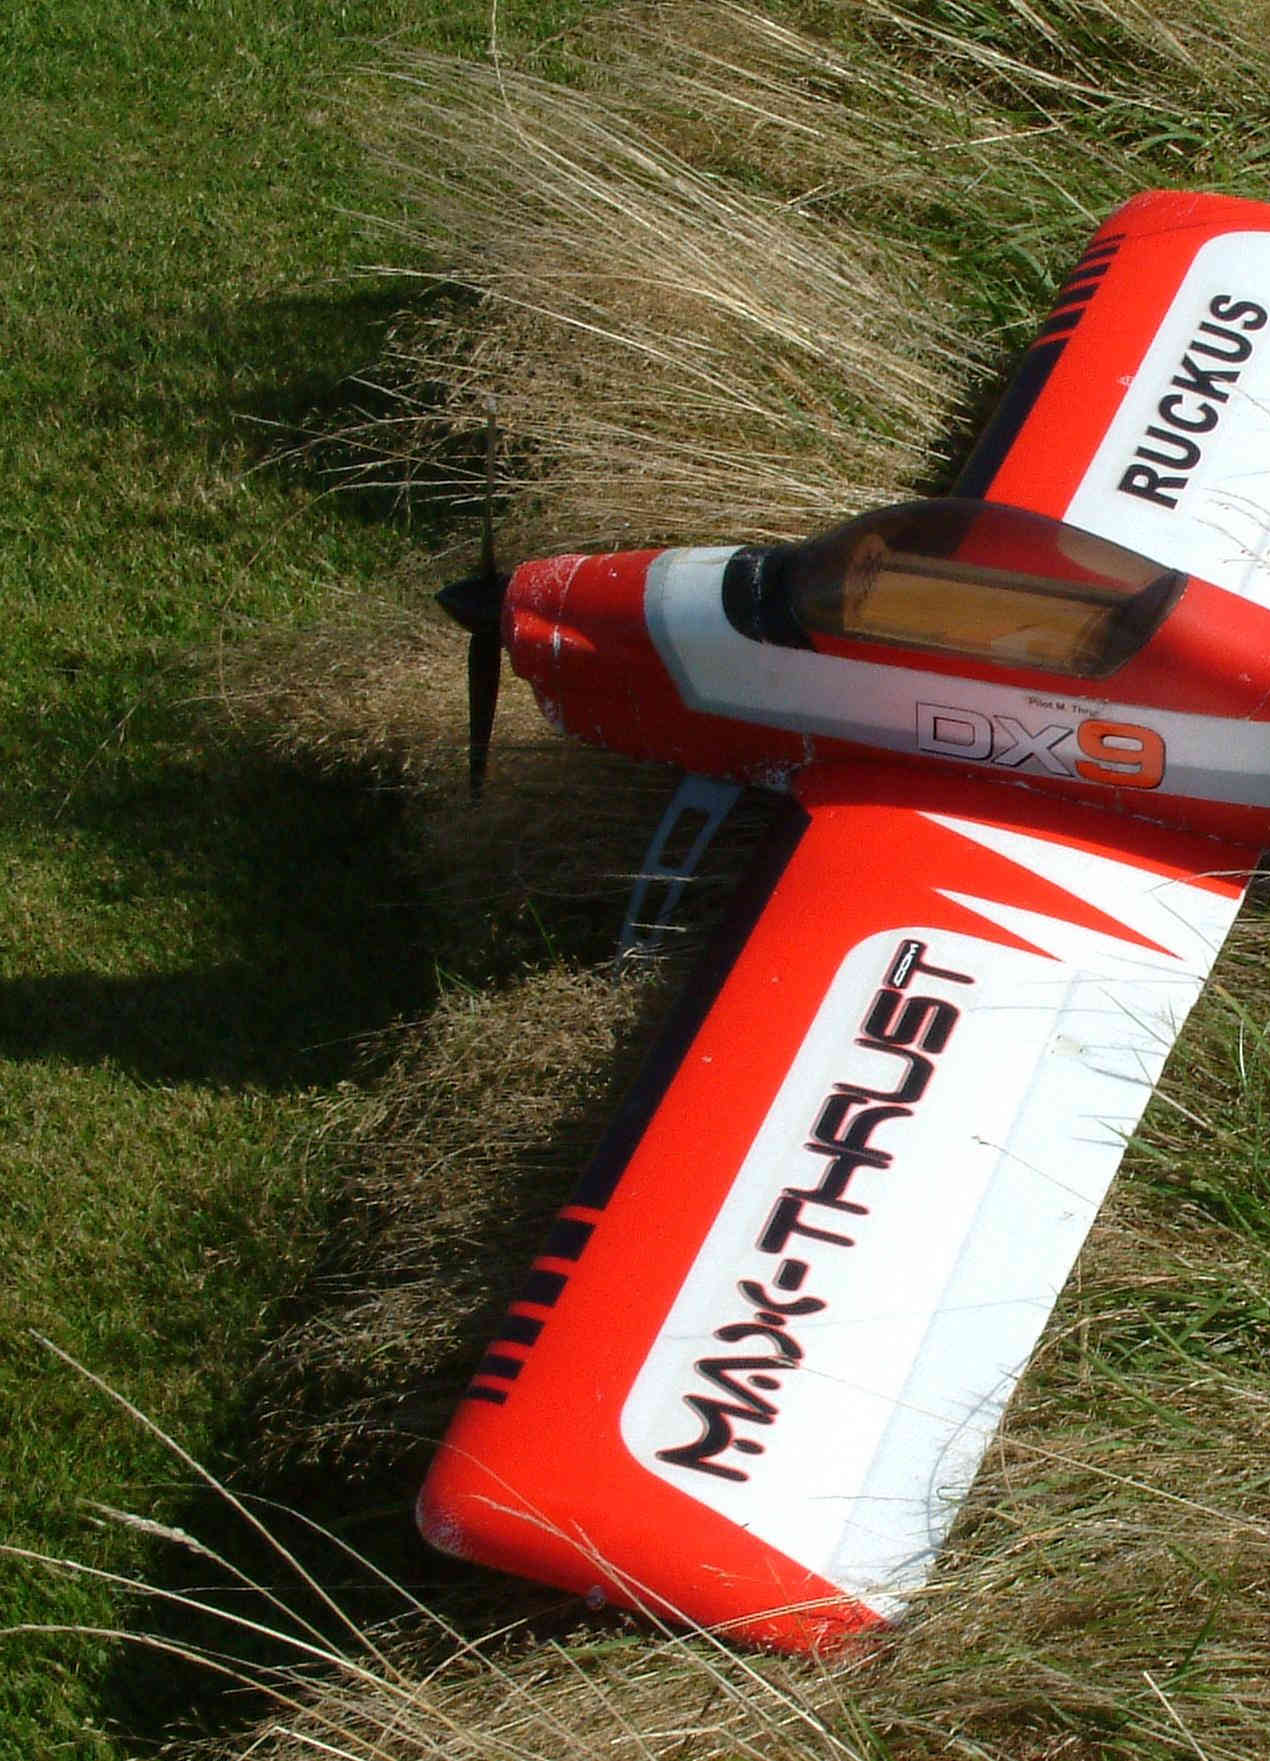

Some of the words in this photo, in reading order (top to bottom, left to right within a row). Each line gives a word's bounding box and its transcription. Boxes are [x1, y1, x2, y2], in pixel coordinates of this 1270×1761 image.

[1117, 294, 1268, 510] RUCKUS
[916, 701, 1166, 789] DX9
[655, 939, 976, 1483] MAX-THRUST
